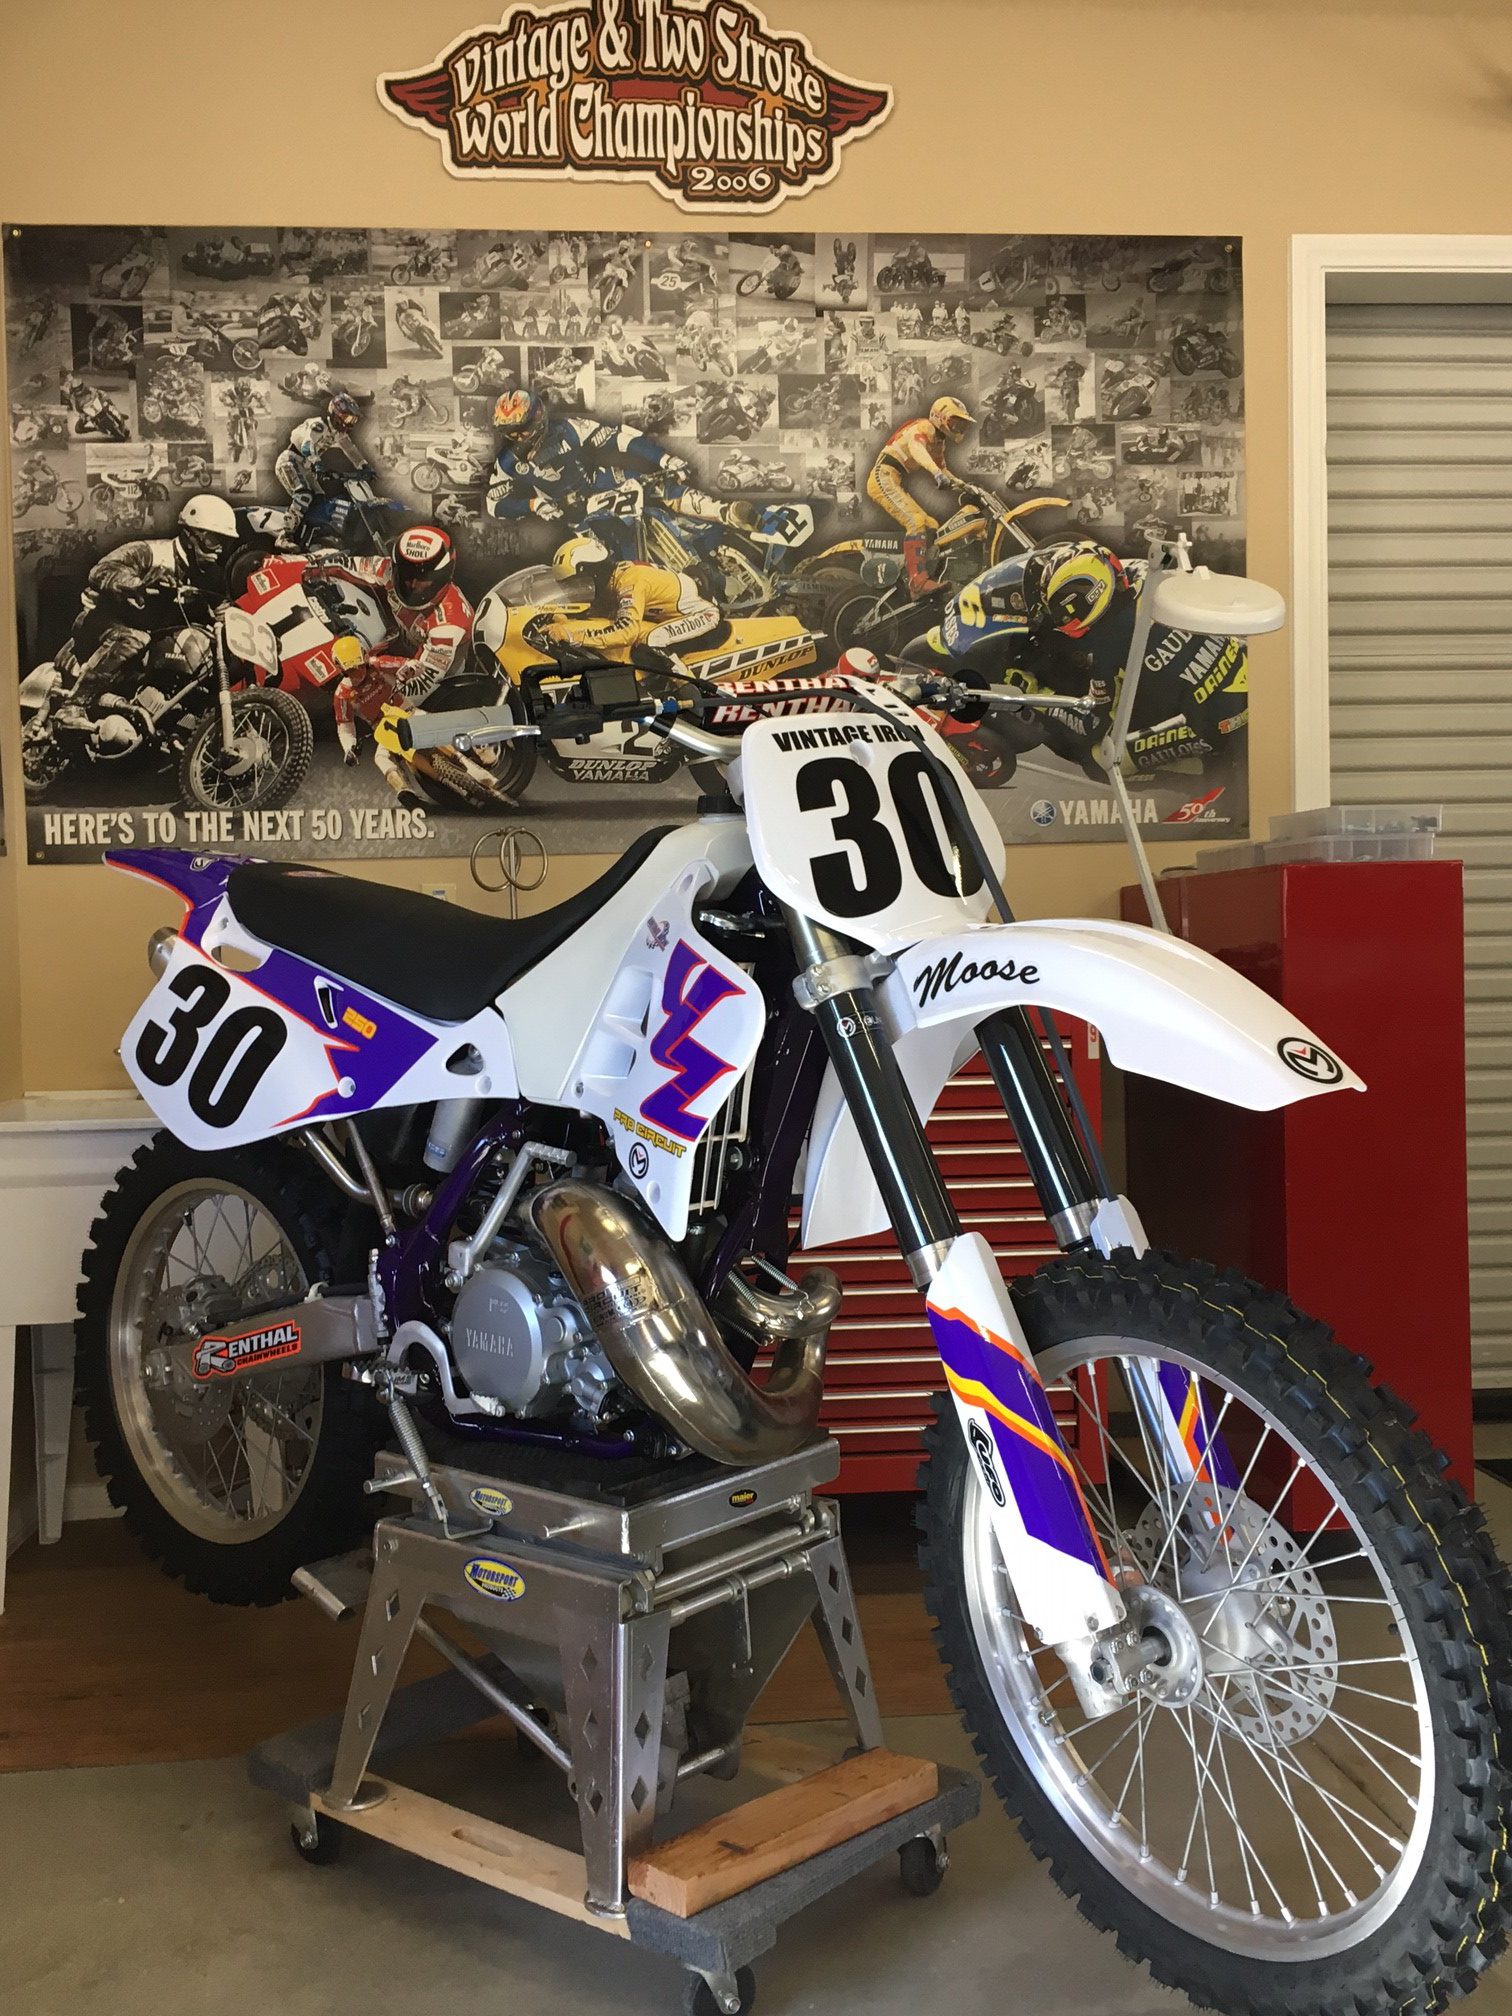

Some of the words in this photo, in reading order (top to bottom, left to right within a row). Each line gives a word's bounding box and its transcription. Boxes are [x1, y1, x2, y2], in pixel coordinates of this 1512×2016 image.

[454, 14, 590, 104] Vintage
[600, 0, 632, 69] &
[639, 0, 702, 74] Two
[715, 6, 823, 111] Stroke
[455, 88, 561, 157] World
[569, 81, 823, 177] Championships
[691, 167, 772, 191] 2006
[660, 275, 678, 287] 25
[864, 538, 899, 550] YAMAHA
[738, 646, 813, 680] DUNLOP
[714, 677, 850, 695] RENTHA
[712, 696, 852, 724] RENTHA
[772, 725, 873, 752] VINTAGE
[568, 759, 658, 771] DUNLOP
[573, 769, 651, 781] YAMAHA
[1059, 798, 1159, 825] YAMAHA
[1176, 802, 1204, 820] 50
[44, 811, 135, 846] HERE'S
[142, 811, 176, 844] TO
[185, 810, 233, 843] THE
[243, 809, 304, 842] NEXT
[312, 809, 343, 841] 50
[351, 808, 436, 841] YEARS.
[796, 751, 986, 919] 30
[912, 951, 1042, 1008] Moose
[342, 1006, 378, 1040] 250
[135, 964, 288, 1129] 30
[613, 1107, 636, 1132] PRO
[636, 1121, 687, 1158] CIRCUIT
[196, 1325, 298, 1374] RENTHAL
[237, 1343, 298, 1366] CHAINWHEELS
[465, 1327, 514, 1358] YAMAHA
[470, 1563, 519, 1587] MOTORSPORT
